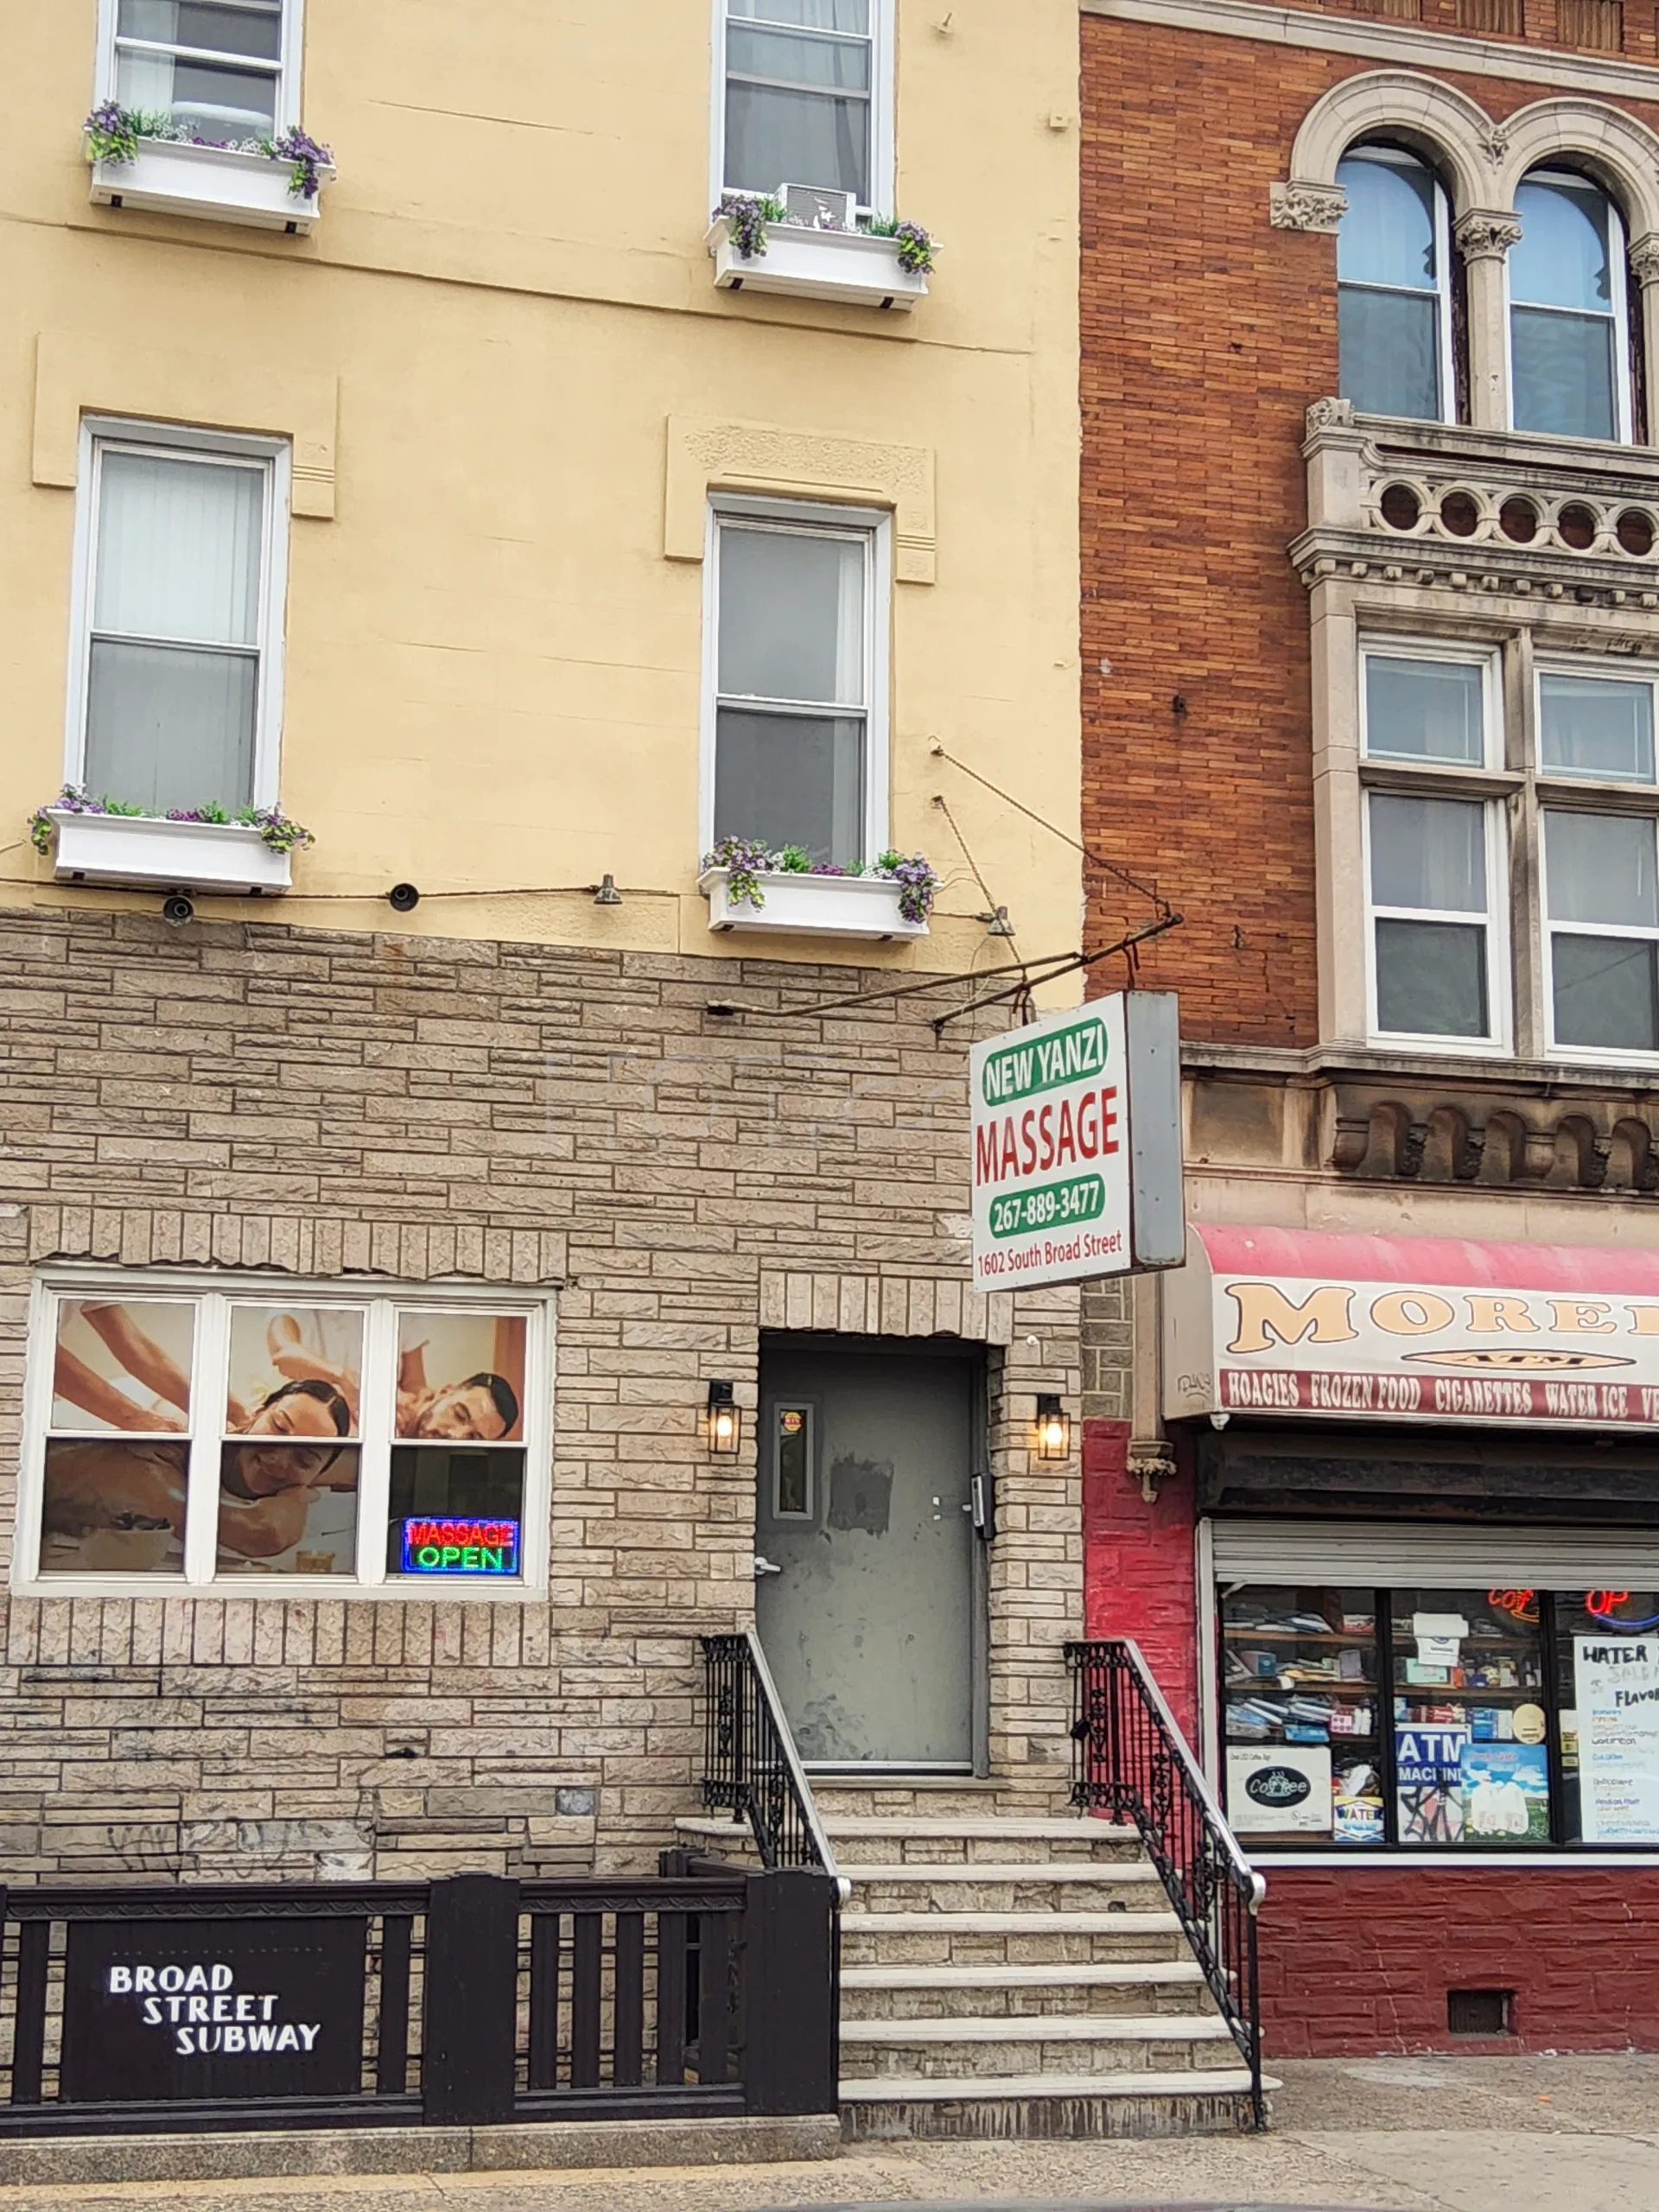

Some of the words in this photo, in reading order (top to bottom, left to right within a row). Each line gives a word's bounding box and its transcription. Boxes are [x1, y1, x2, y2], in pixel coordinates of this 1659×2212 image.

[985, 1046, 1033, 1100] NEW
[1038, 1024, 1104, 1081] YANZI
[976, 1085, 1120, 1187] MASSAGE
[994, 1180, 1101, 1232] 267-889-3477
[978, 1249, 1006, 1277] 1602
[1007, 1243, 1043, 1272] South
[1045, 1237, 1081, 1264] Broad
[1084, 1230, 1122, 1258] Street
[1228, 1371, 1300, 1406] HOAGIES
[1311, 1373, 1373, 1408] FROZEN
[1377, 1376, 1421, 1409] FOOD
[1435, 1379, 1533, 1414] CIGARETTES
[1545, 1383, 1598, 1416] WATER
[1602, 1385, 1629, 1418] ICE
[407, 1522, 514, 1547] MASSAGE
[417, 1547, 503, 1569] OPEN
[1398, 1733, 1466, 1763] ATM
[109, 1964, 233, 1994] BROAD
[143, 1994, 279, 2025] STREET
[175, 2024, 321, 2056] SUBWAY
